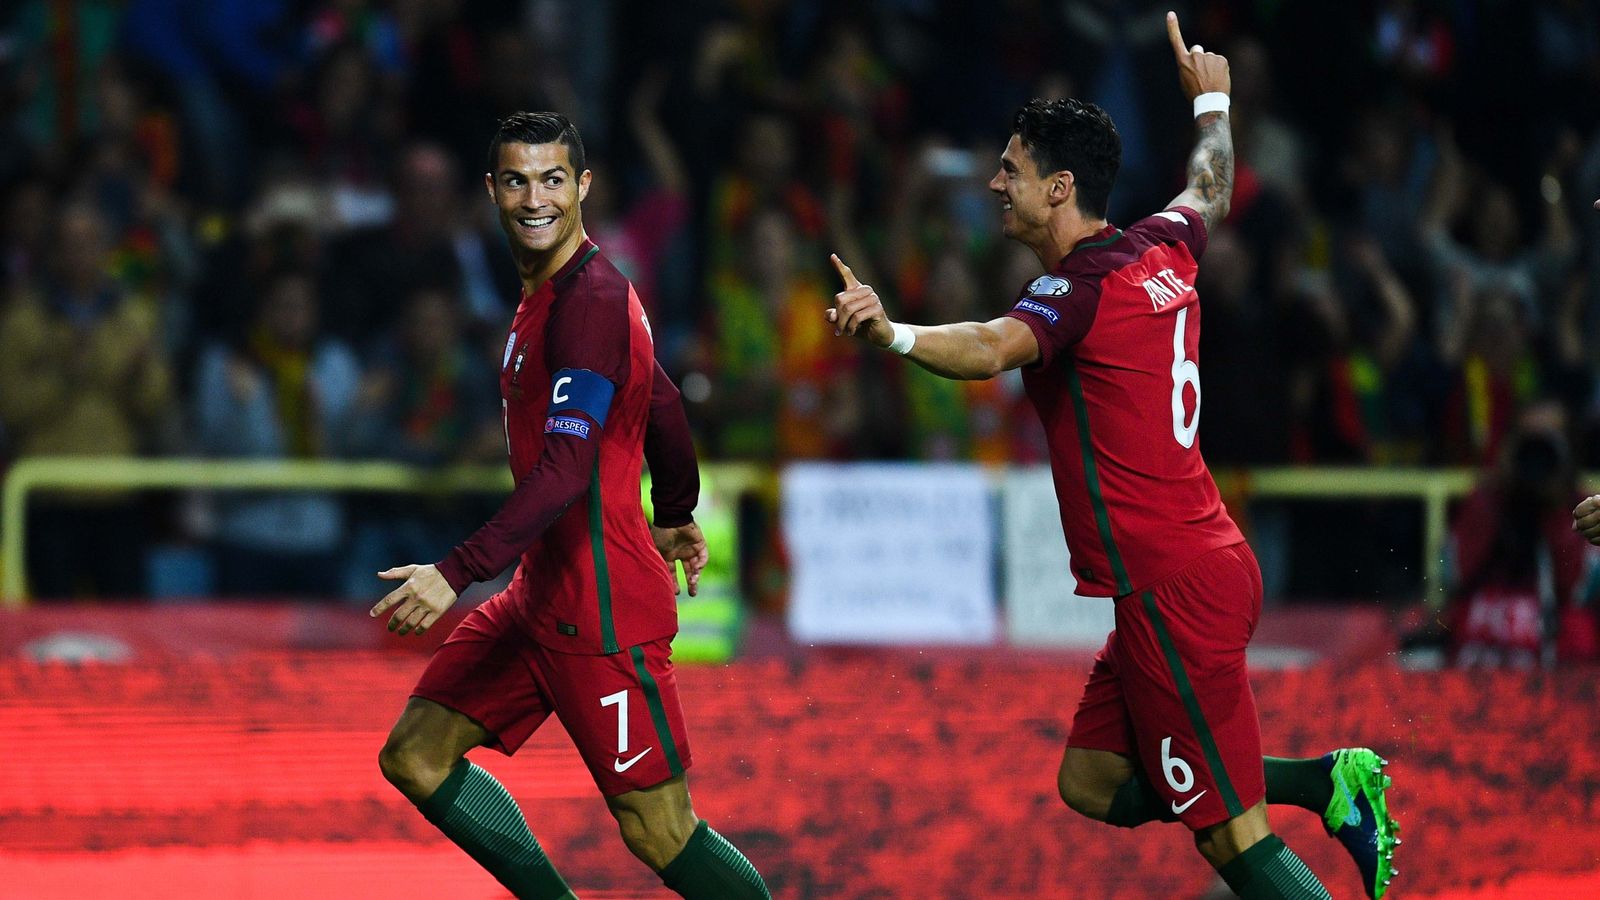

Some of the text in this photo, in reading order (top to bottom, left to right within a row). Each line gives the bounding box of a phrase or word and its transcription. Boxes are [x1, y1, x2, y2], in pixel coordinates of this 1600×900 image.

[1022, 302, 1058, 322] RESPECT
[552, 376, 572, 404] C
[1171, 307, 1202, 449] 6
[554, 420, 590, 435] RESPECT
[600, 689, 628, 753] 7
[1161, 736, 1195, 793] 6
